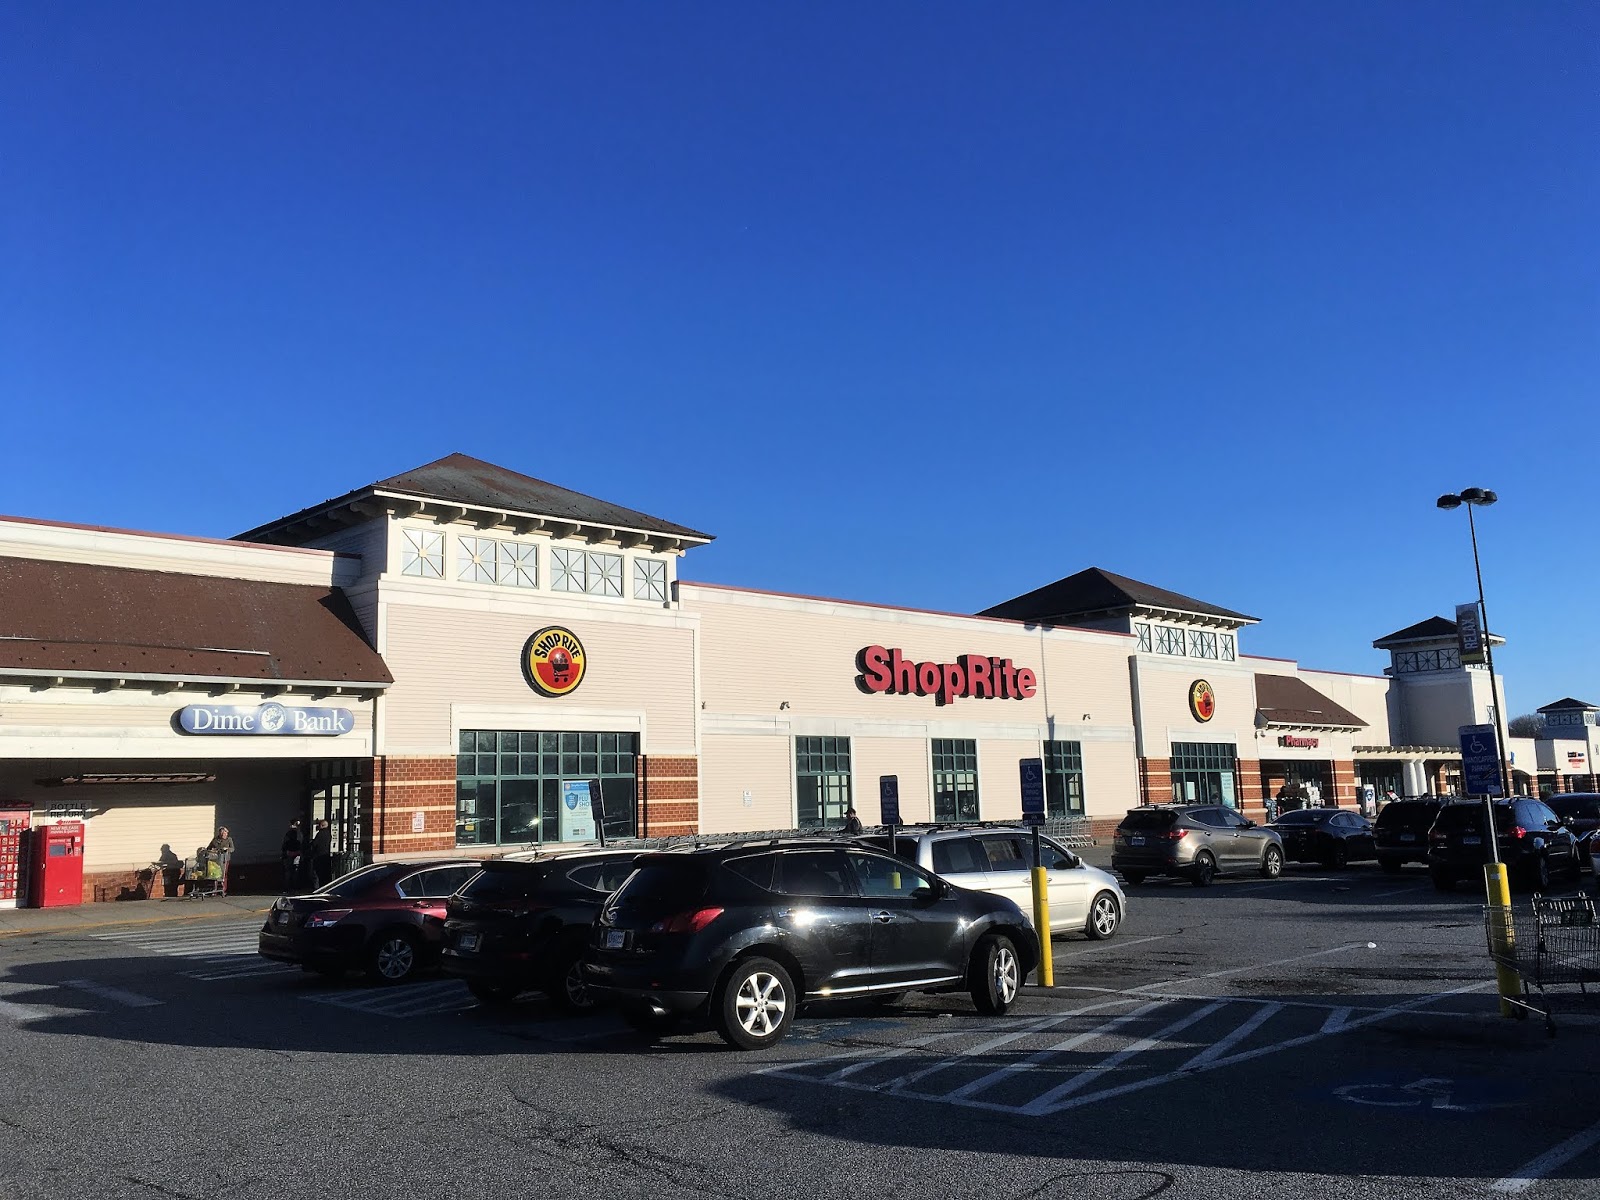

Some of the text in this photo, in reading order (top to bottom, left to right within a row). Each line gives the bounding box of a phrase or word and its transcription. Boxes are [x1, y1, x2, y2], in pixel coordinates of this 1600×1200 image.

[1461, 617, 1478, 649] RELAX
[534, 633, 581, 659] SHOP RITE
[857, 645, 1037, 705] ShopRite
[192, 708, 346, 731] Dime Bank
[1284, 735, 1319, 750] Pharmacy
[50, 803, 87, 811] BOTTLE
